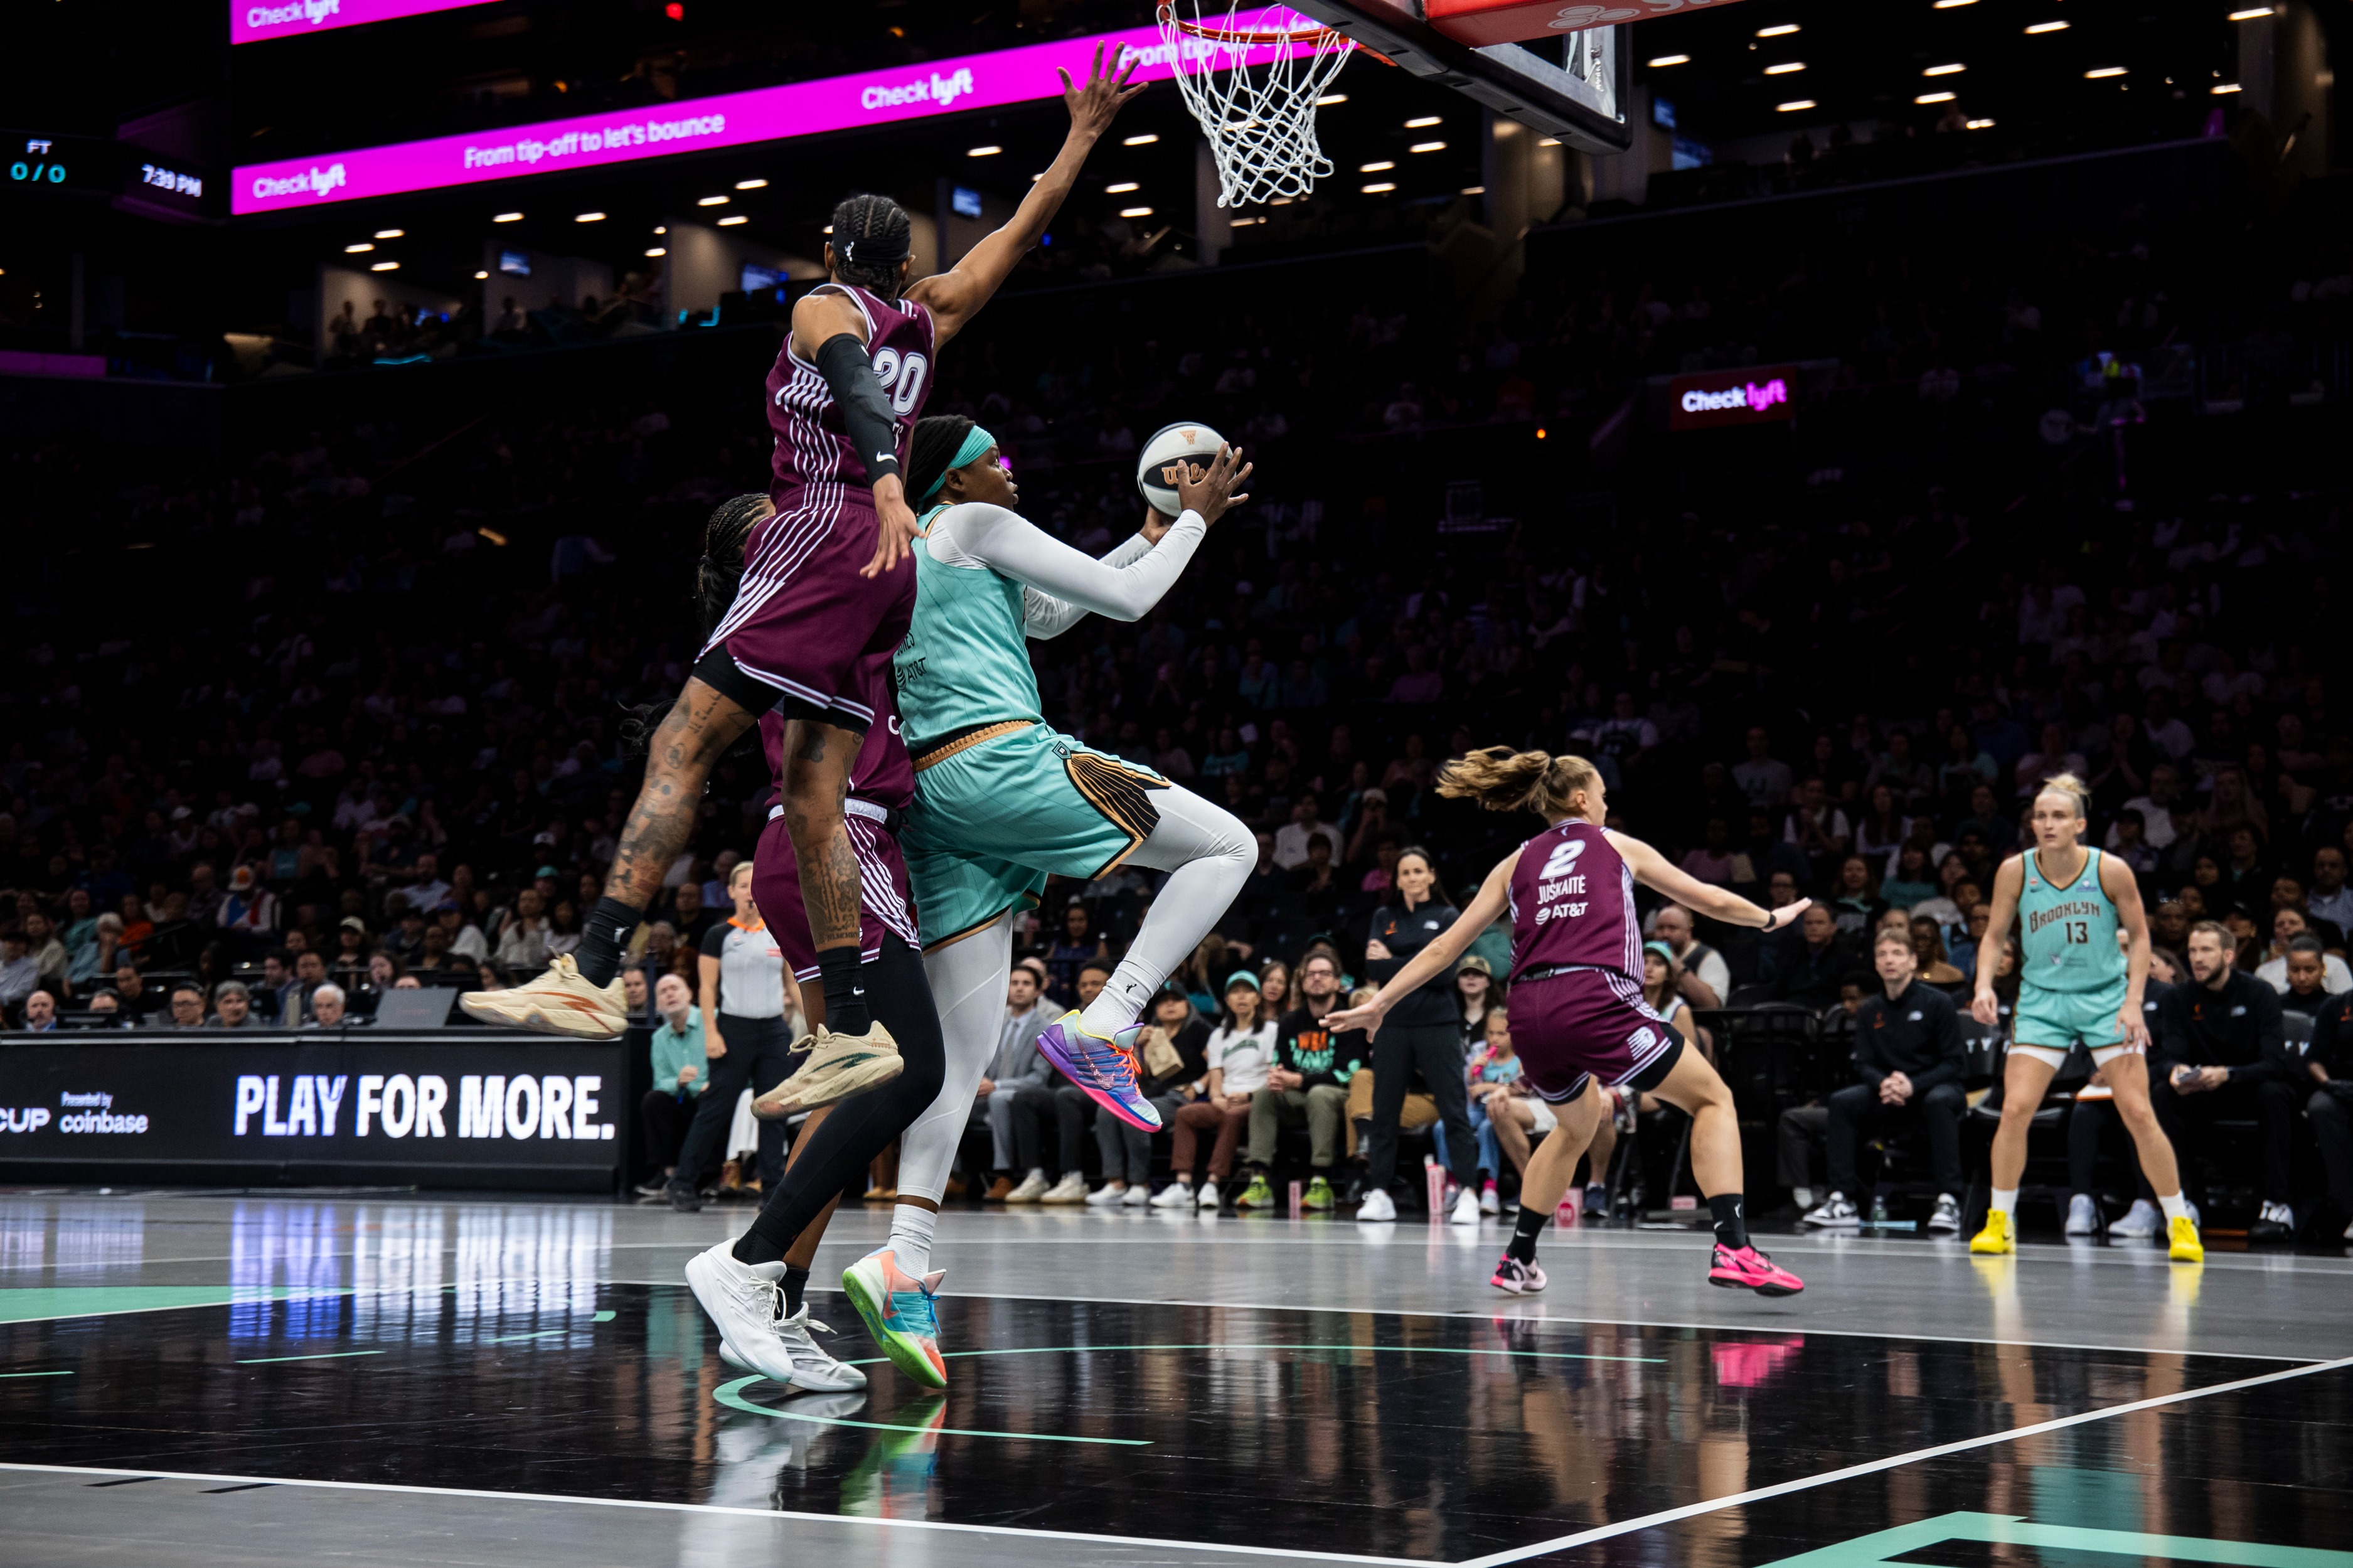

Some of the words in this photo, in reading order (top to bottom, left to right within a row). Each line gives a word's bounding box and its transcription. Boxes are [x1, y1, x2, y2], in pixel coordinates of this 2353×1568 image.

[247, 6, 304, 28] Check
[861, 79, 931, 110] Check
[931, 67, 974, 106] lyft
[26, 139, 53, 154] FT
[464, 146, 515, 169] From
[516, 131, 580, 164] tip-off
[581, 131, 602, 152] to
[603, 124, 646, 149] let's
[647, 114, 725, 142] bounce
[142, 164, 176, 189] 7:39
[175, 173, 202, 197] PM
[252, 173, 311, 198] Check
[310, 163, 346, 197] lyft
[872, 346, 927, 416] 20
[1682, 387, 1747, 412] Check
[1746, 378, 1787, 411] lyft
[906, 657, 927, 683] AT&T
[1539, 839, 1586, 880] 2
[1552, 902, 1589, 919] AT&T
[2029, 901, 2101, 934] BROOKLYN
[2065, 921, 2089, 944] 13
[61, 1091, 100, 1107] Presented
[100, 1091, 114, 1109] by
[233, 1074, 348, 1136] PLAY
[355, 1074, 448, 1139] FOR
[458, 1074, 616, 1140] MORE.
[59, 1109, 149, 1134] coinbase
